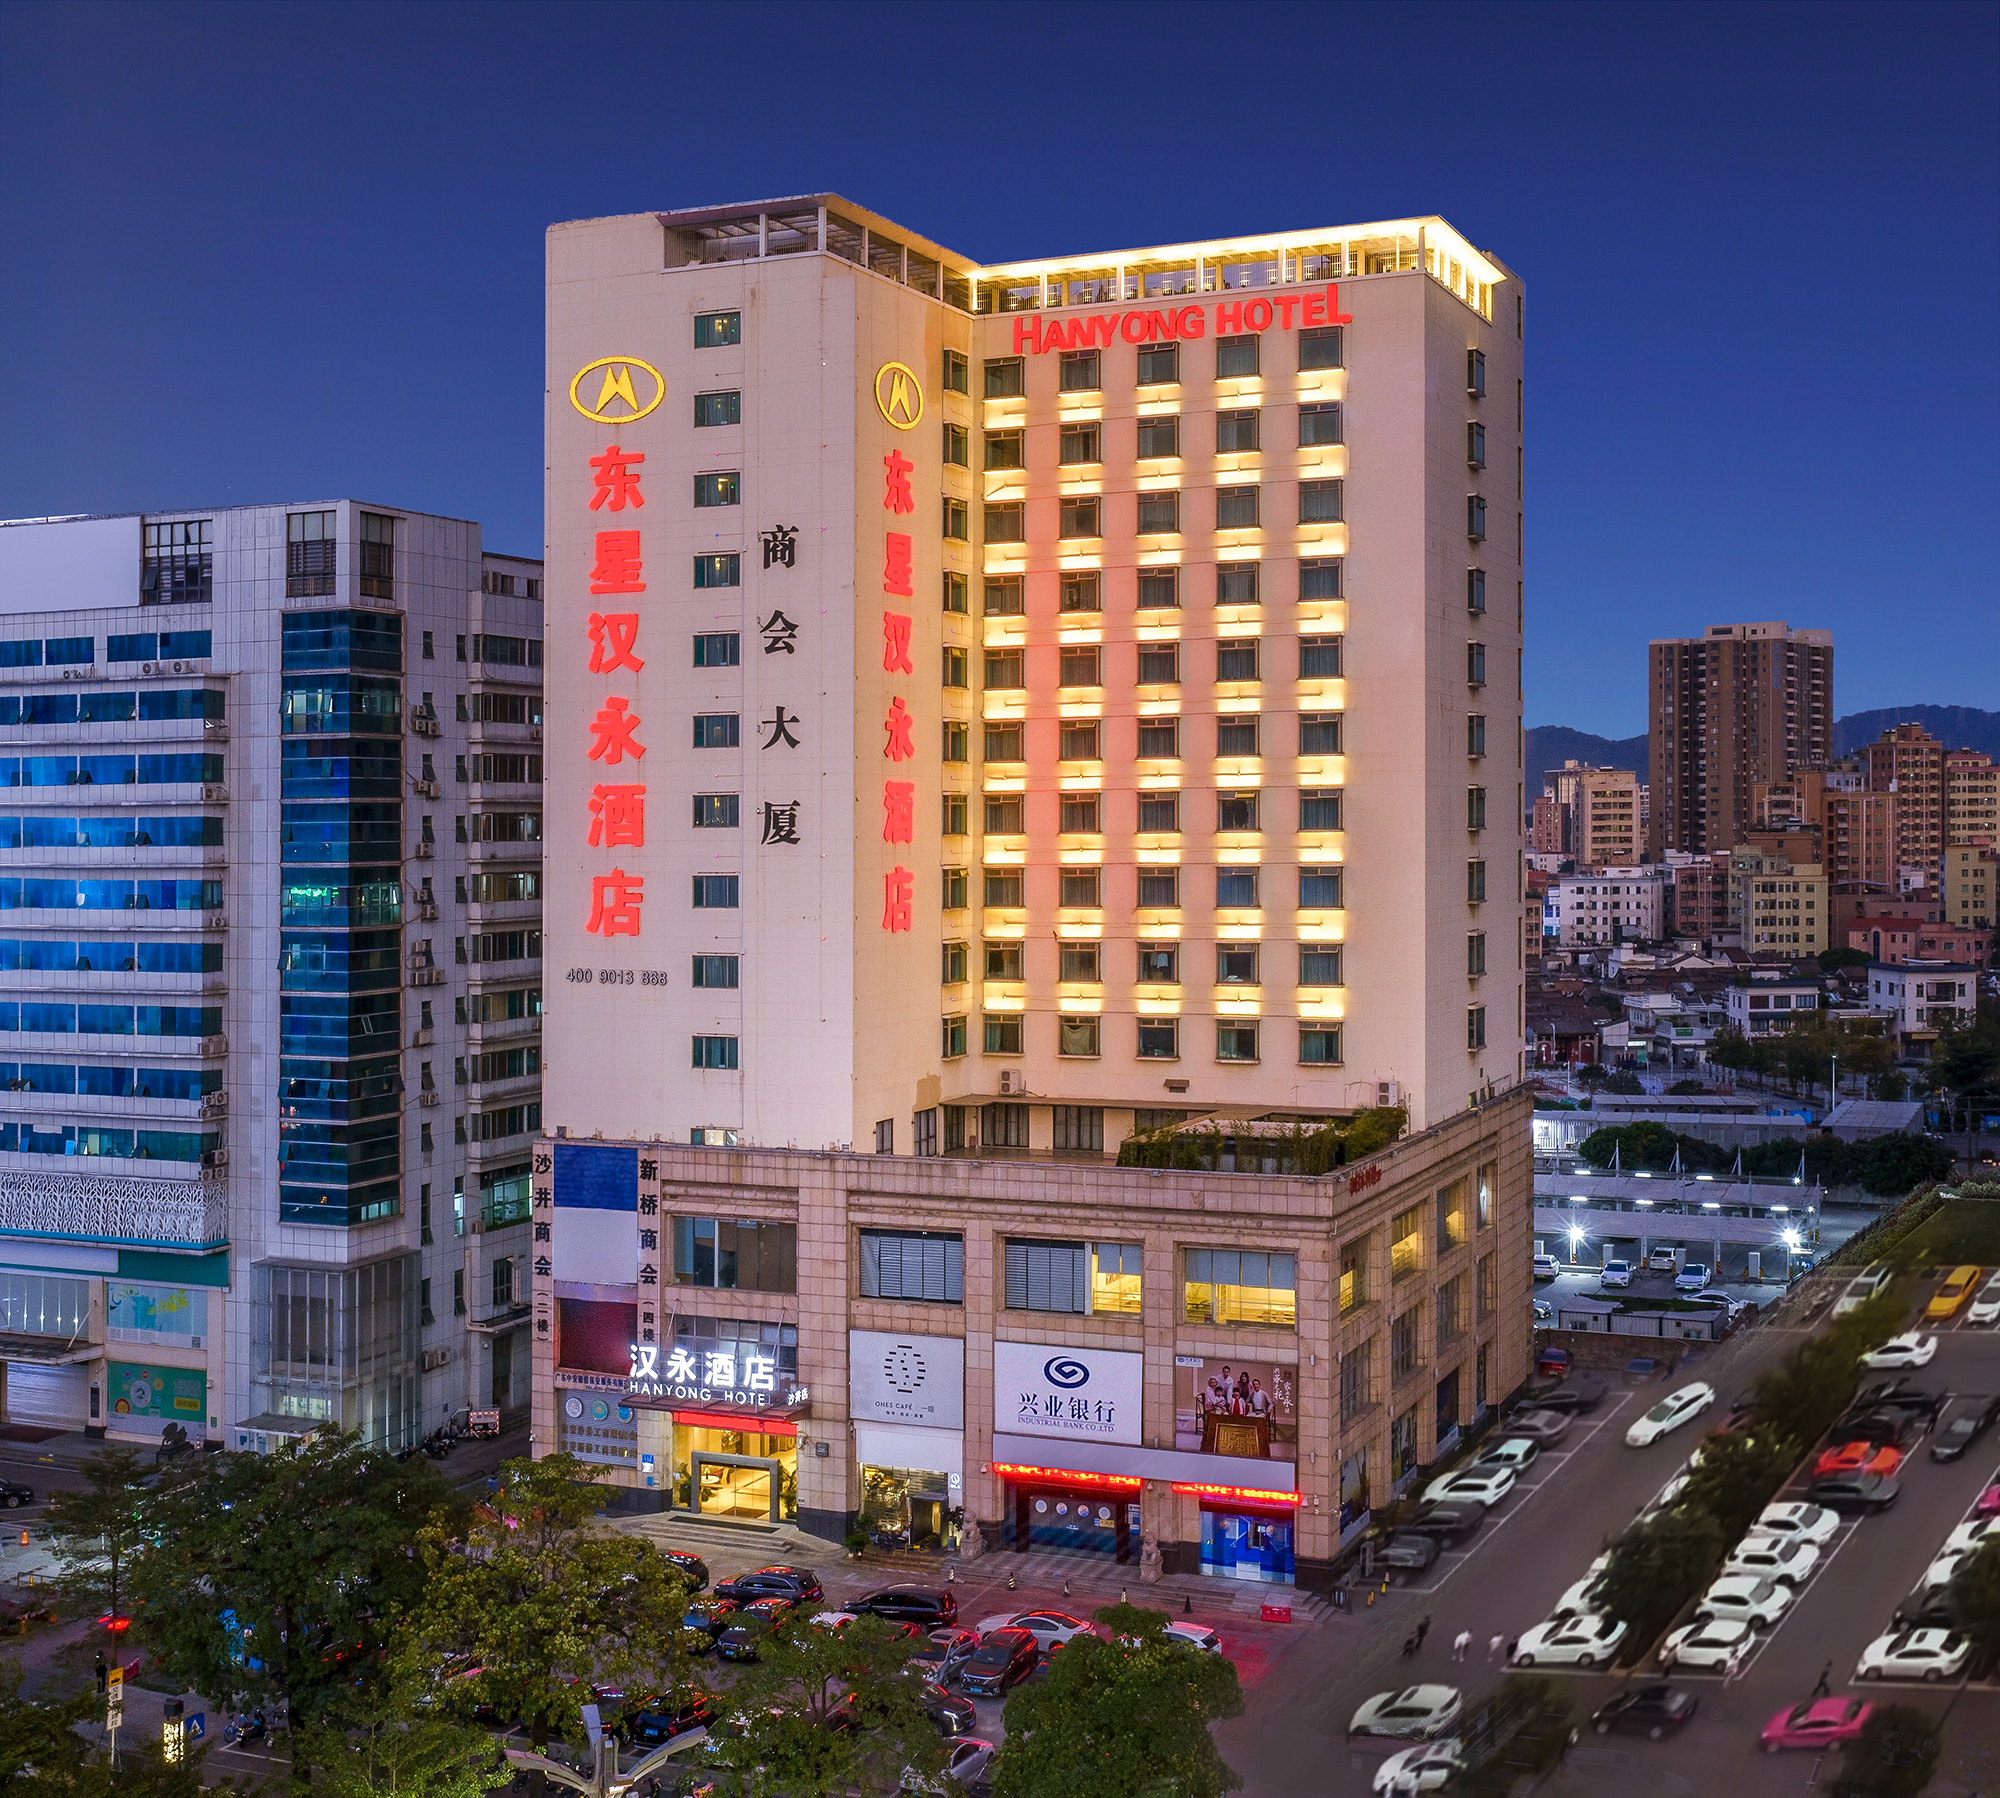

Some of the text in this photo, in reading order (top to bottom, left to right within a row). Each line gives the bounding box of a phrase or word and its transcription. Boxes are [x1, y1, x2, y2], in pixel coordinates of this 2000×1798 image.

[1013, 283, 1353, 355] HANYONG HOTEL
[586, 445, 646, 937] 东星汉永酒店
[759, 523, 801, 846] 商会大厦
[883, 448, 915, 934] 东星汉永酒店
[566, 968, 668, 987] 400 9013 868
[629, 1344, 776, 1391] 汉永酒店
[629, 1381, 712, 1401] HANYONG
[875, 1400, 893, 1408] ONES
[895, 1402, 913, 1411] CAFÉ
[1018, 1392, 1116, 1423] 兴业银行
[1018, 1416, 1062, 1428] INDUSTRIAL
[1063, 1421, 1084, 1430] BANK
